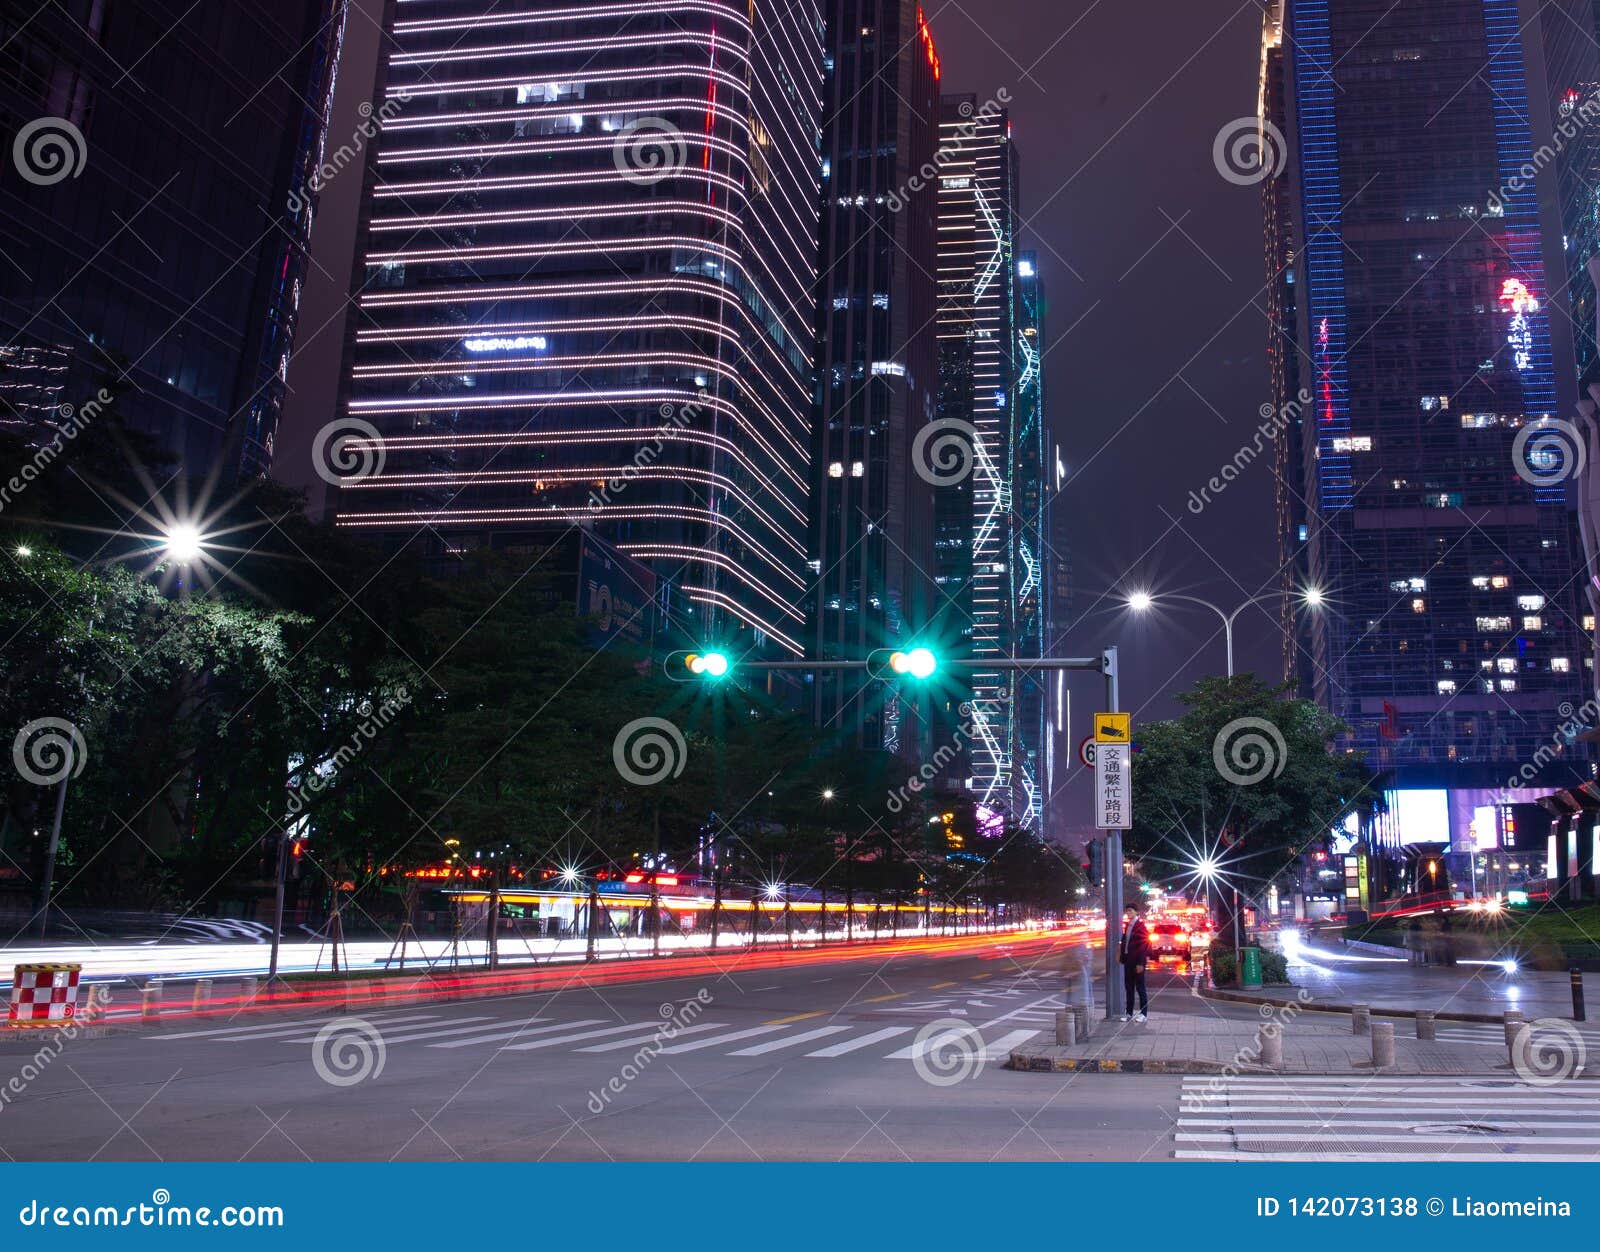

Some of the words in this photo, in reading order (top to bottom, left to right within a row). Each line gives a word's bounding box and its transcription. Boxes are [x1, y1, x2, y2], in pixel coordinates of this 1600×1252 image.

[1104, 748, 1122, 825] 交通繁忙路段
